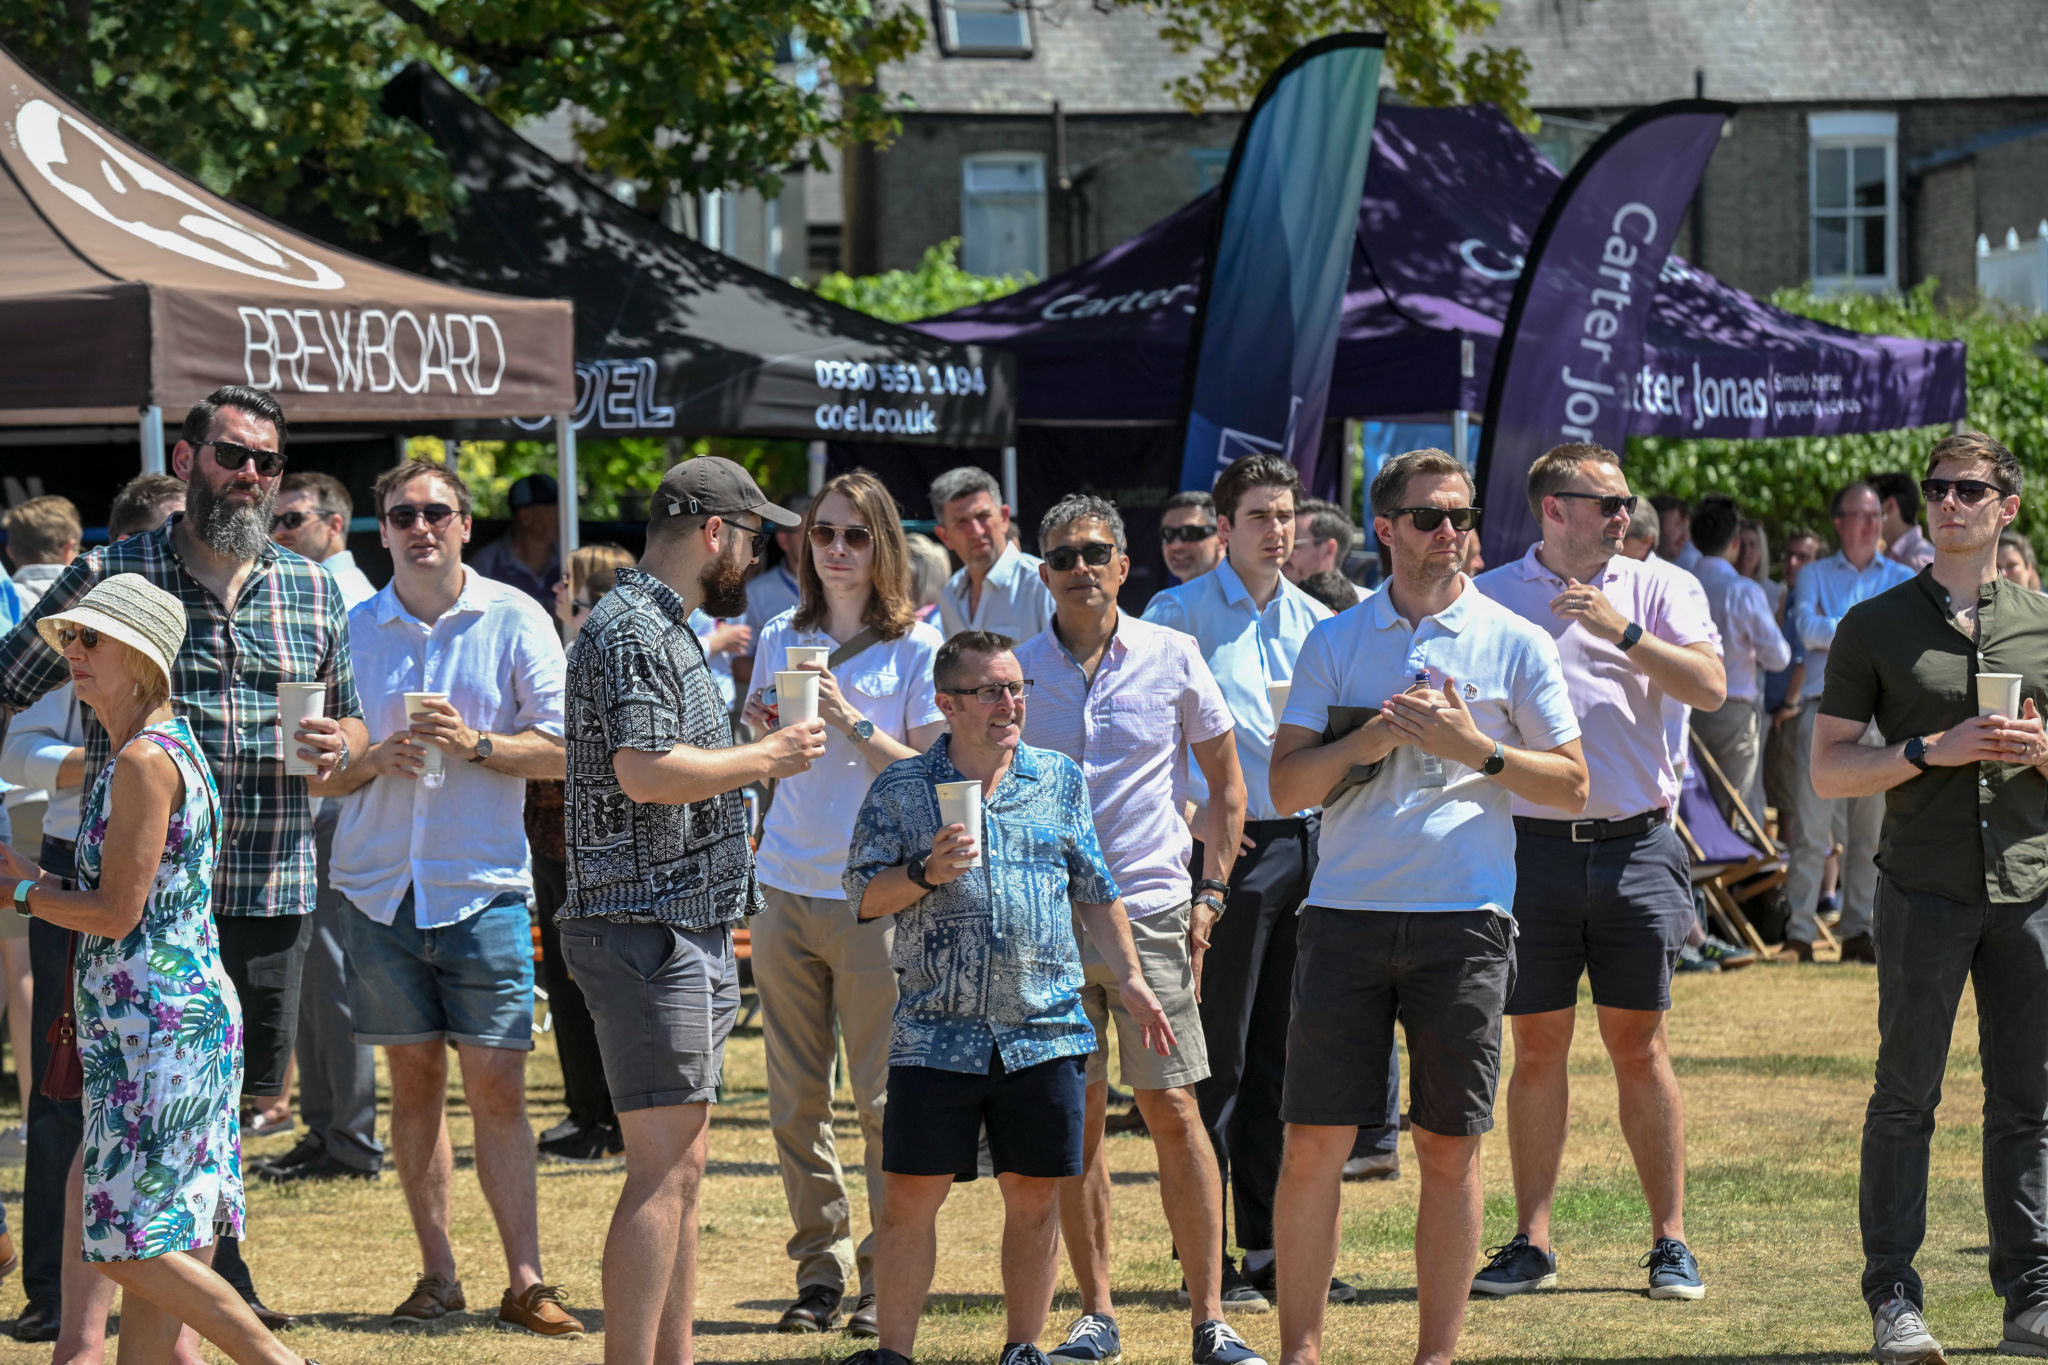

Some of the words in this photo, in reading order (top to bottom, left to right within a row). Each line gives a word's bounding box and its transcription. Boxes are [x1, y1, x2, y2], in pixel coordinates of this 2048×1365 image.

[1041, 284, 1192, 321] Carter
[1580, 202, 1658, 364] Carter
[238, 307, 506, 395] BREWBOARD
[815, 359, 876, 391] 0330
[877, 363, 925, 394] 551
[927, 364, 987, 397] 1494
[511, 357, 675, 431] OEL
[814, 398, 938, 434] coel.co.uk
[1692, 361, 1769, 430] Jonas
